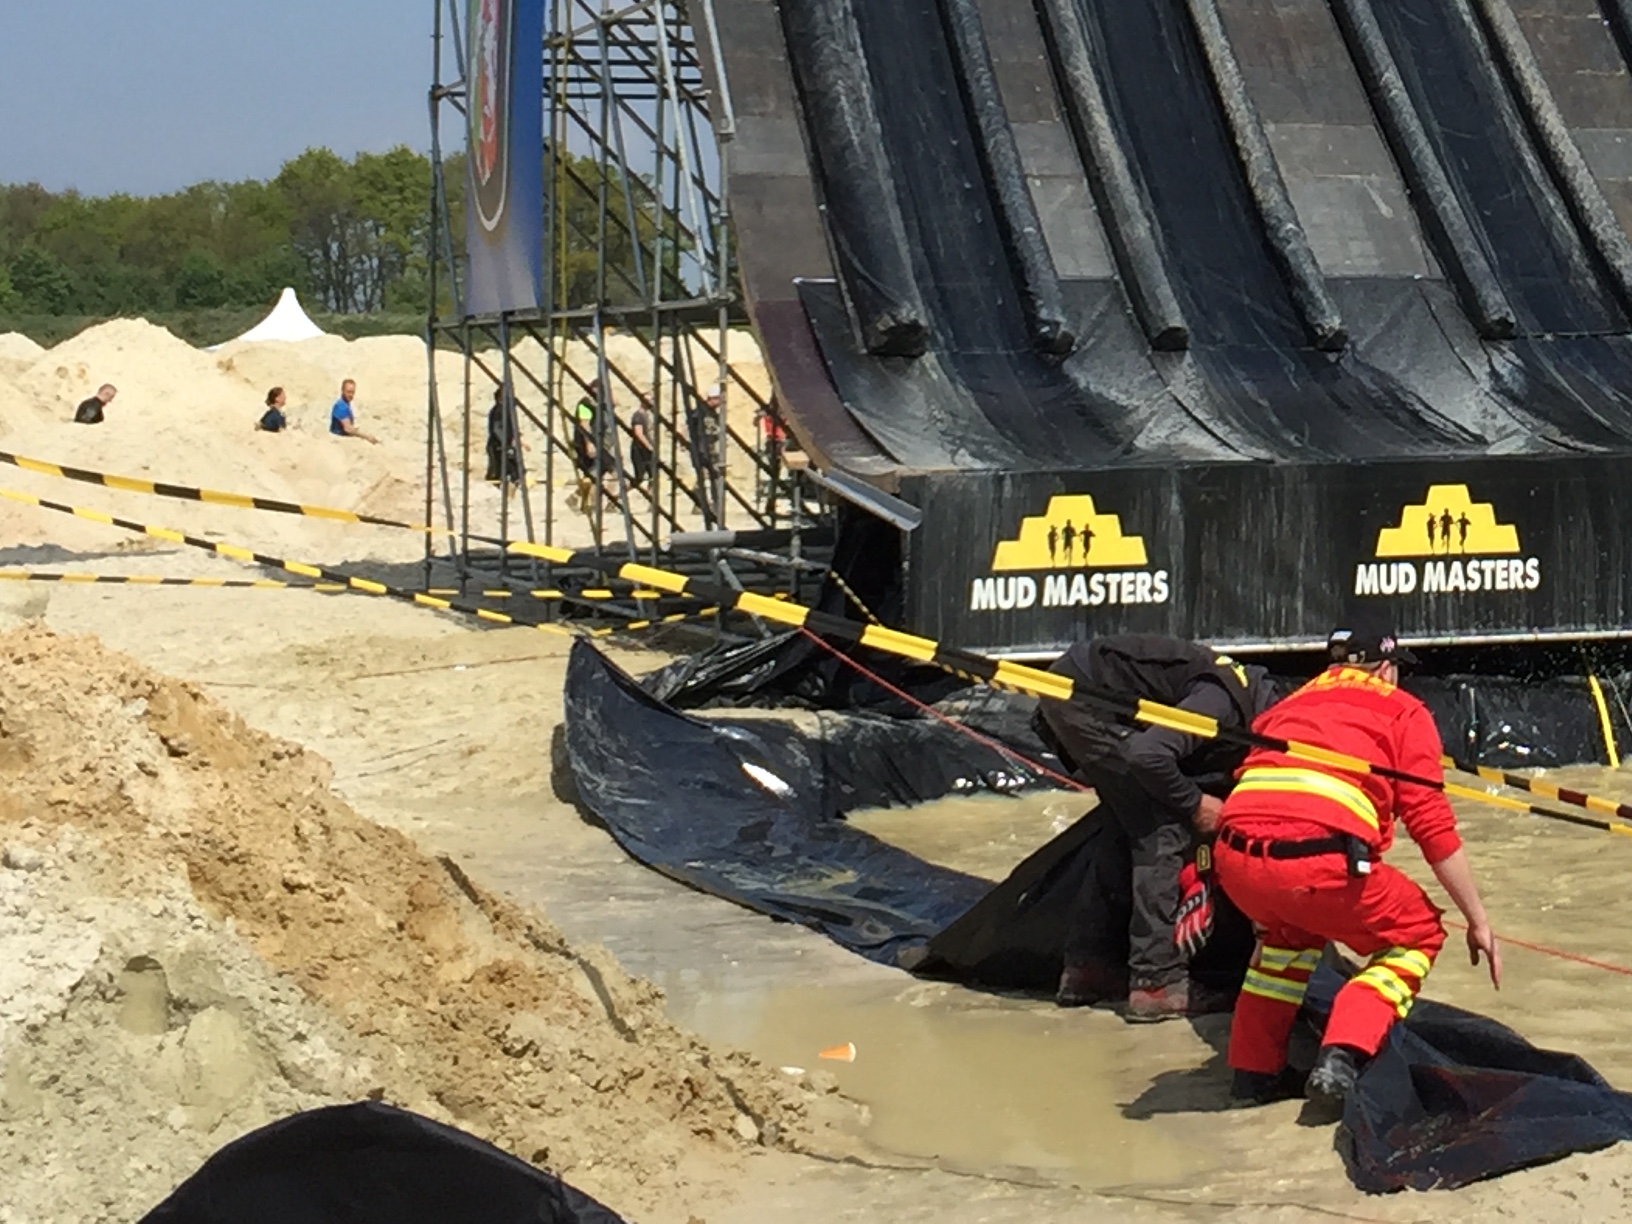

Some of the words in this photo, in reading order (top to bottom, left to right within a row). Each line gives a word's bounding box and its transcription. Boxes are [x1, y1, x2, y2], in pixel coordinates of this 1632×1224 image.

[970, 575, 1037, 611] MUD
[1042, 569, 1170, 607] MASTERS
[1354, 562, 1417, 596] MUD
[1422, 557, 1541, 593] MASTERS
